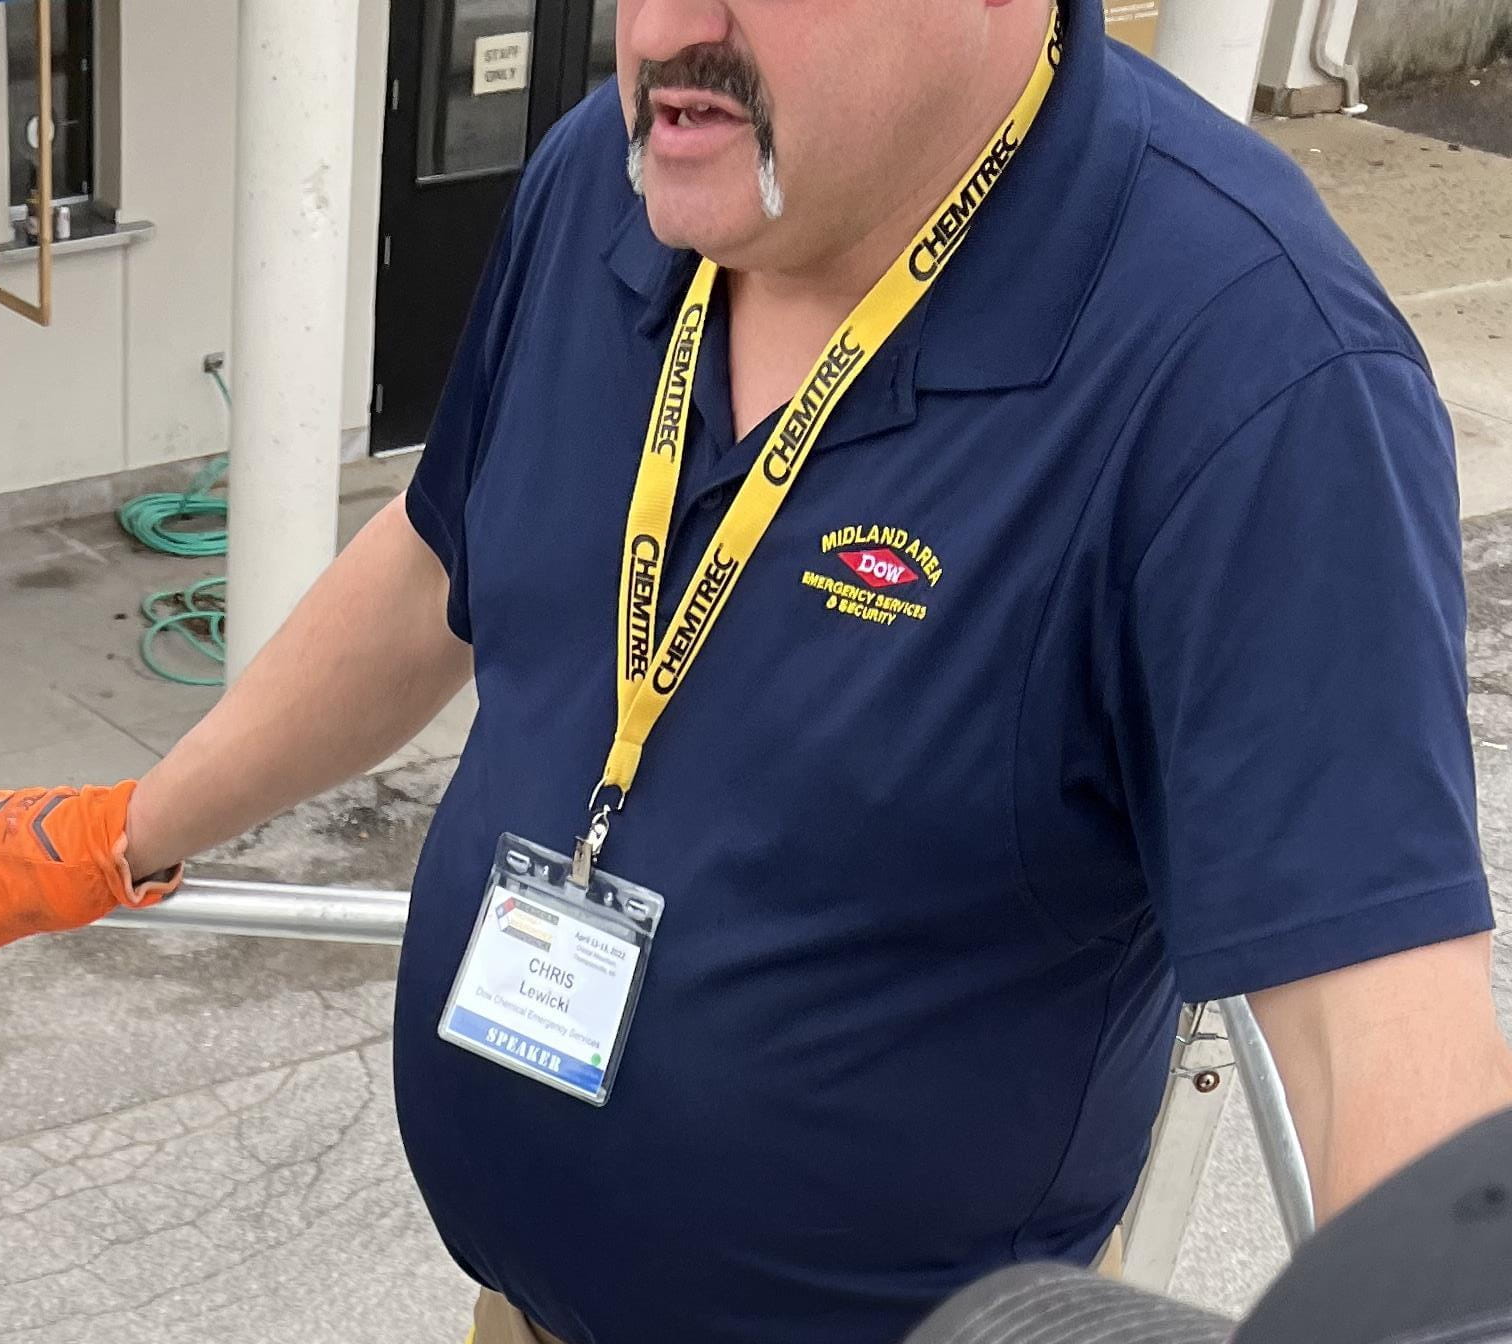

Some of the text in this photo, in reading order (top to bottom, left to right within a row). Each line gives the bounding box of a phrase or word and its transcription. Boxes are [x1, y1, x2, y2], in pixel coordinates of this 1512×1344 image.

[908, 119, 1019, 283] CHEMTREC
[653, 303, 703, 464] CHEMTREC
[763, 326, 865, 487] CHEMTREC
[821, 525, 943, 587] MIDLAND AREA
[857, 554, 906, 583] DOW
[626, 533, 660, 682] CHEMTREC
[652, 542, 739, 696] CHEMTREC
[802, 571, 927, 620] EMERGENCY SERVICES
[839, 599, 897, 626] SECURITY
[519, 979, 570, 1013] Lewicki
[529, 957, 575, 989] CHRIS
[527, 1009, 568, 1036] Emergency
[486, 1026, 562, 1073] SPEAKER
